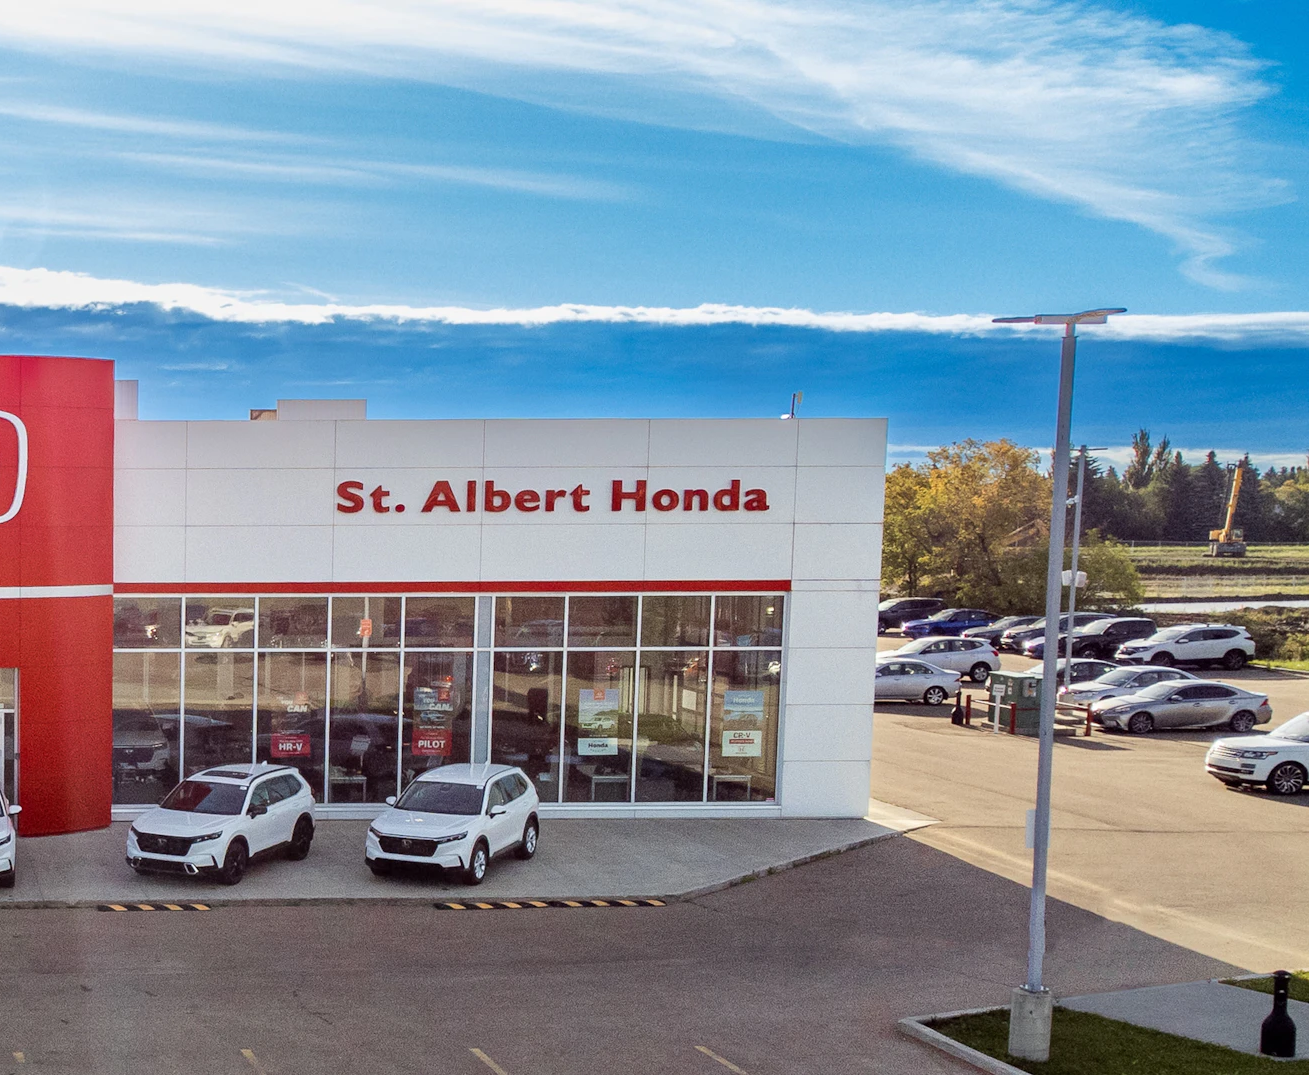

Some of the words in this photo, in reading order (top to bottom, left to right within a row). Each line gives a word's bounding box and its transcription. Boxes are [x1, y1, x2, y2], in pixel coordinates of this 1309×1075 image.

[336, 480, 406, 513] St.
[420, 479, 591, 513] Albert
[611, 479, 771, 513] Honda
[286, 704, 308, 713] CAN
[278, 742, 303, 752] HR-V
[418, 740, 446, 749] PILOT
